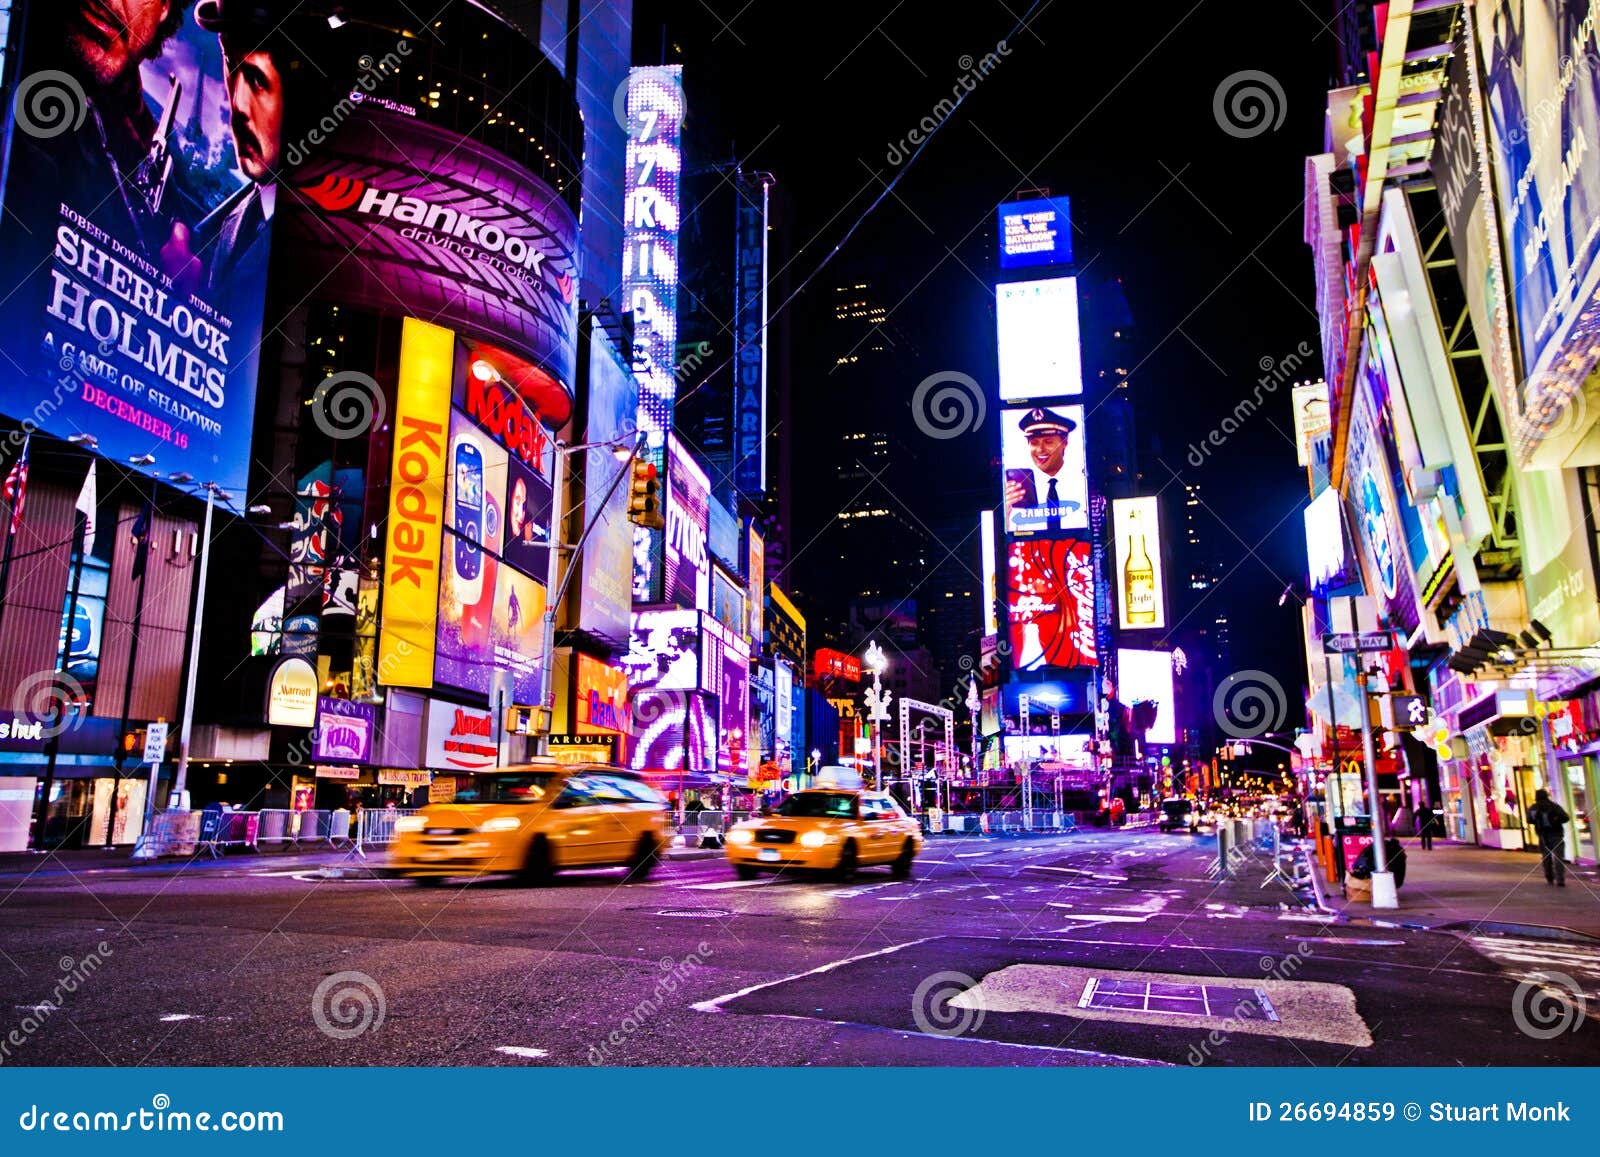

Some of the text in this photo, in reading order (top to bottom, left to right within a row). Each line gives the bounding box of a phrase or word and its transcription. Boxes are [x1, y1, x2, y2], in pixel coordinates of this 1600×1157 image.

[59, 203, 111, 244] ROBERT
[111, 239, 159, 278] DOWNEY
[400, 226, 543, 291] driving emotion
[55, 225, 230, 364] SHERLOCK
[190, 294, 232, 329] JUDE LAW
[46, 268, 225, 409] HOLMES
[41, 331, 222, 438] A GAME OF SHADOWS
[81, 381, 188, 450] DECEMBER 16
[740, 321, 761, 456] SQUARE
[467, 371, 547, 476] Kodak
[391, 416, 443, 589] Kodak
[1020, 506, 1074, 519] SAMSUNG
[1361, 637, 1383, 648] WAY
[278, 684, 312, 698] Marriott
[11, 718, 43, 740] hut
